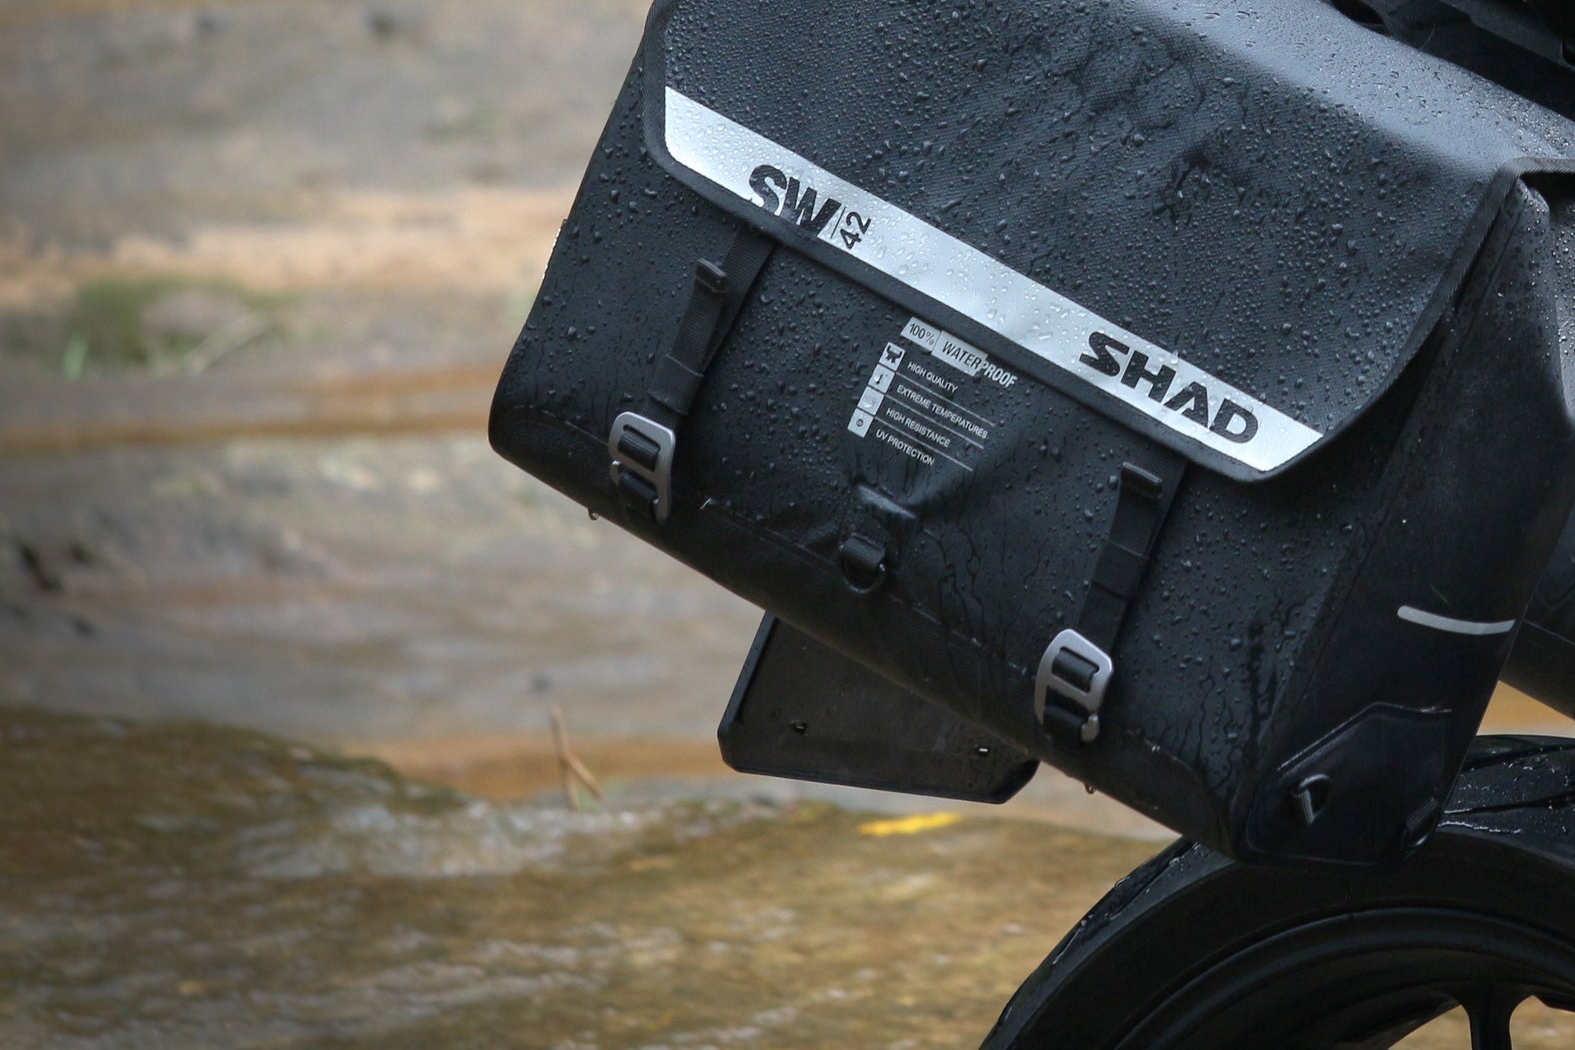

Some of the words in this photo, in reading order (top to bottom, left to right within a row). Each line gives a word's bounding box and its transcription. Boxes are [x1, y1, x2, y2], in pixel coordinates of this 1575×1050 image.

[748, 164, 842, 238] SW
[840, 211, 872, 250] 42
[907, 361, 926, 378] HIGH
[925, 371, 959, 394] QUALITY
[908, 322, 935, 347] 100%
[942, 340, 1018, 389] WATERPROOF
[896, 384, 932, 410] EXTREME
[930, 402, 989, 439] TEMPERATURES
[1078, 331, 1260, 445] SHAD
[875, 428, 889, 441] UV
[886, 434, 935, 467] PROTECTION
[885, 407, 906, 424] HIGH
[903, 417, 952, 448] RESISTANCE
